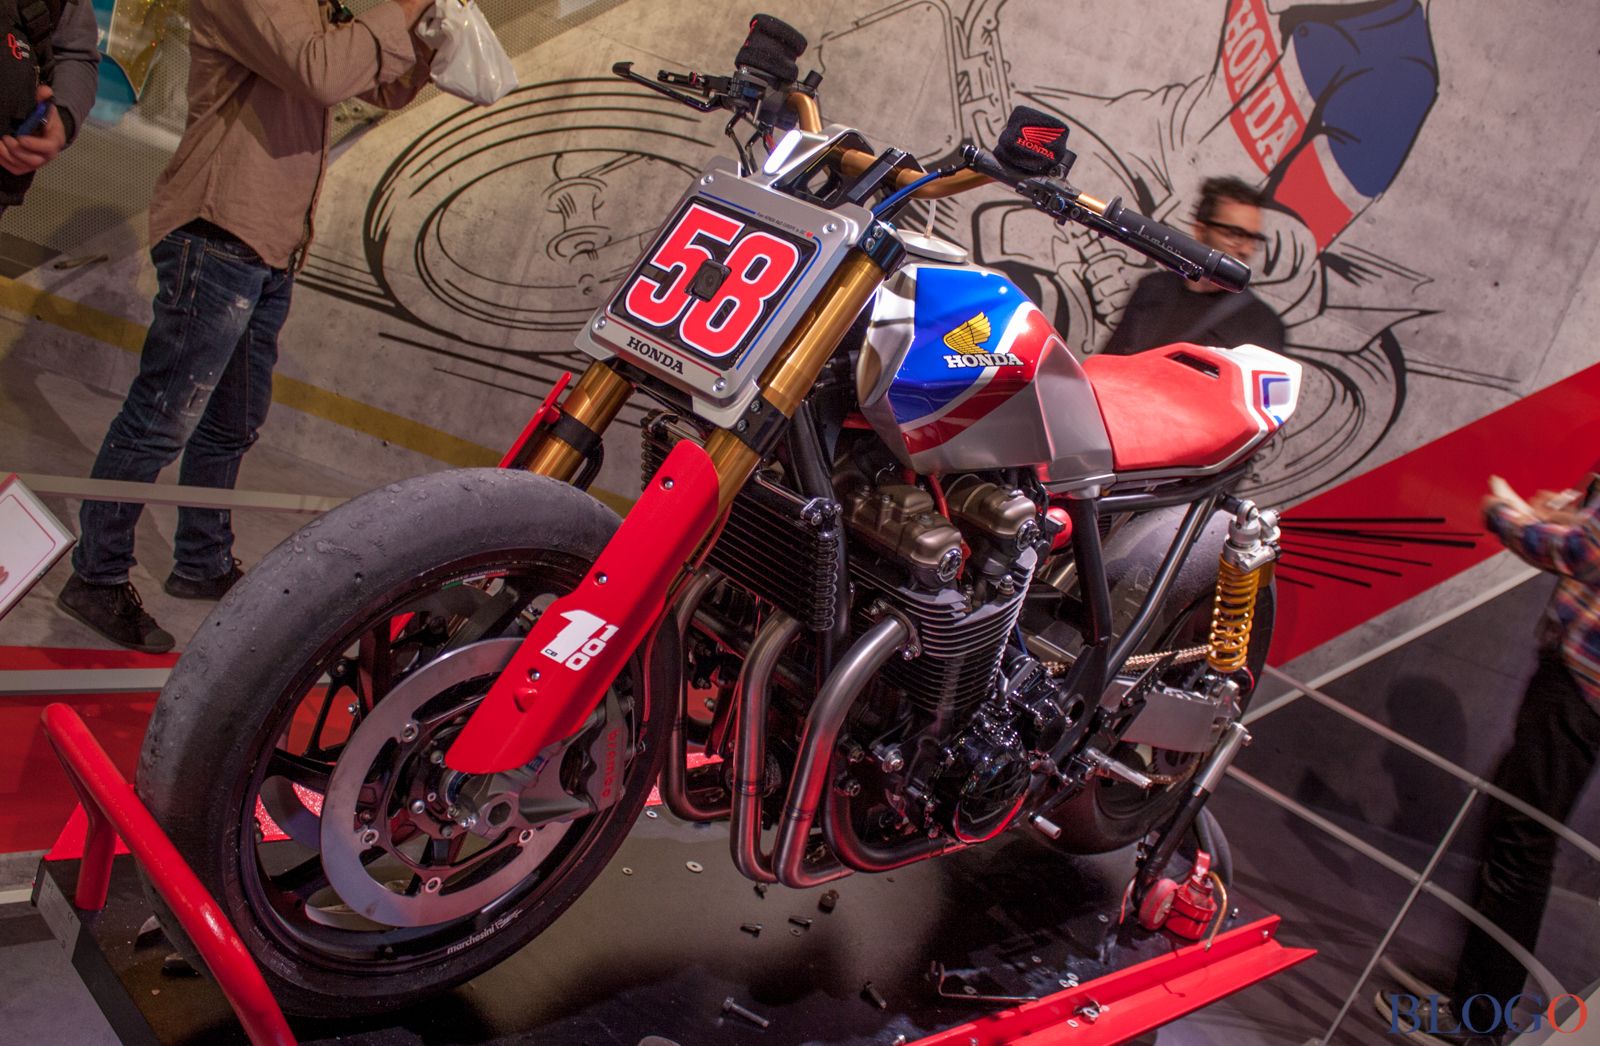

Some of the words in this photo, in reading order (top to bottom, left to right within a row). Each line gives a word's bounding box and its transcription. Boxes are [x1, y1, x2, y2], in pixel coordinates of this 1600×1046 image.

[1224, 0, 1299, 171] HONDA
[1016, 137, 1055, 161] HONDA
[625, 203, 799, 357] 58
[626, 336, 684, 375] HONDA
[943, 352, 1025, 369] HONDA
